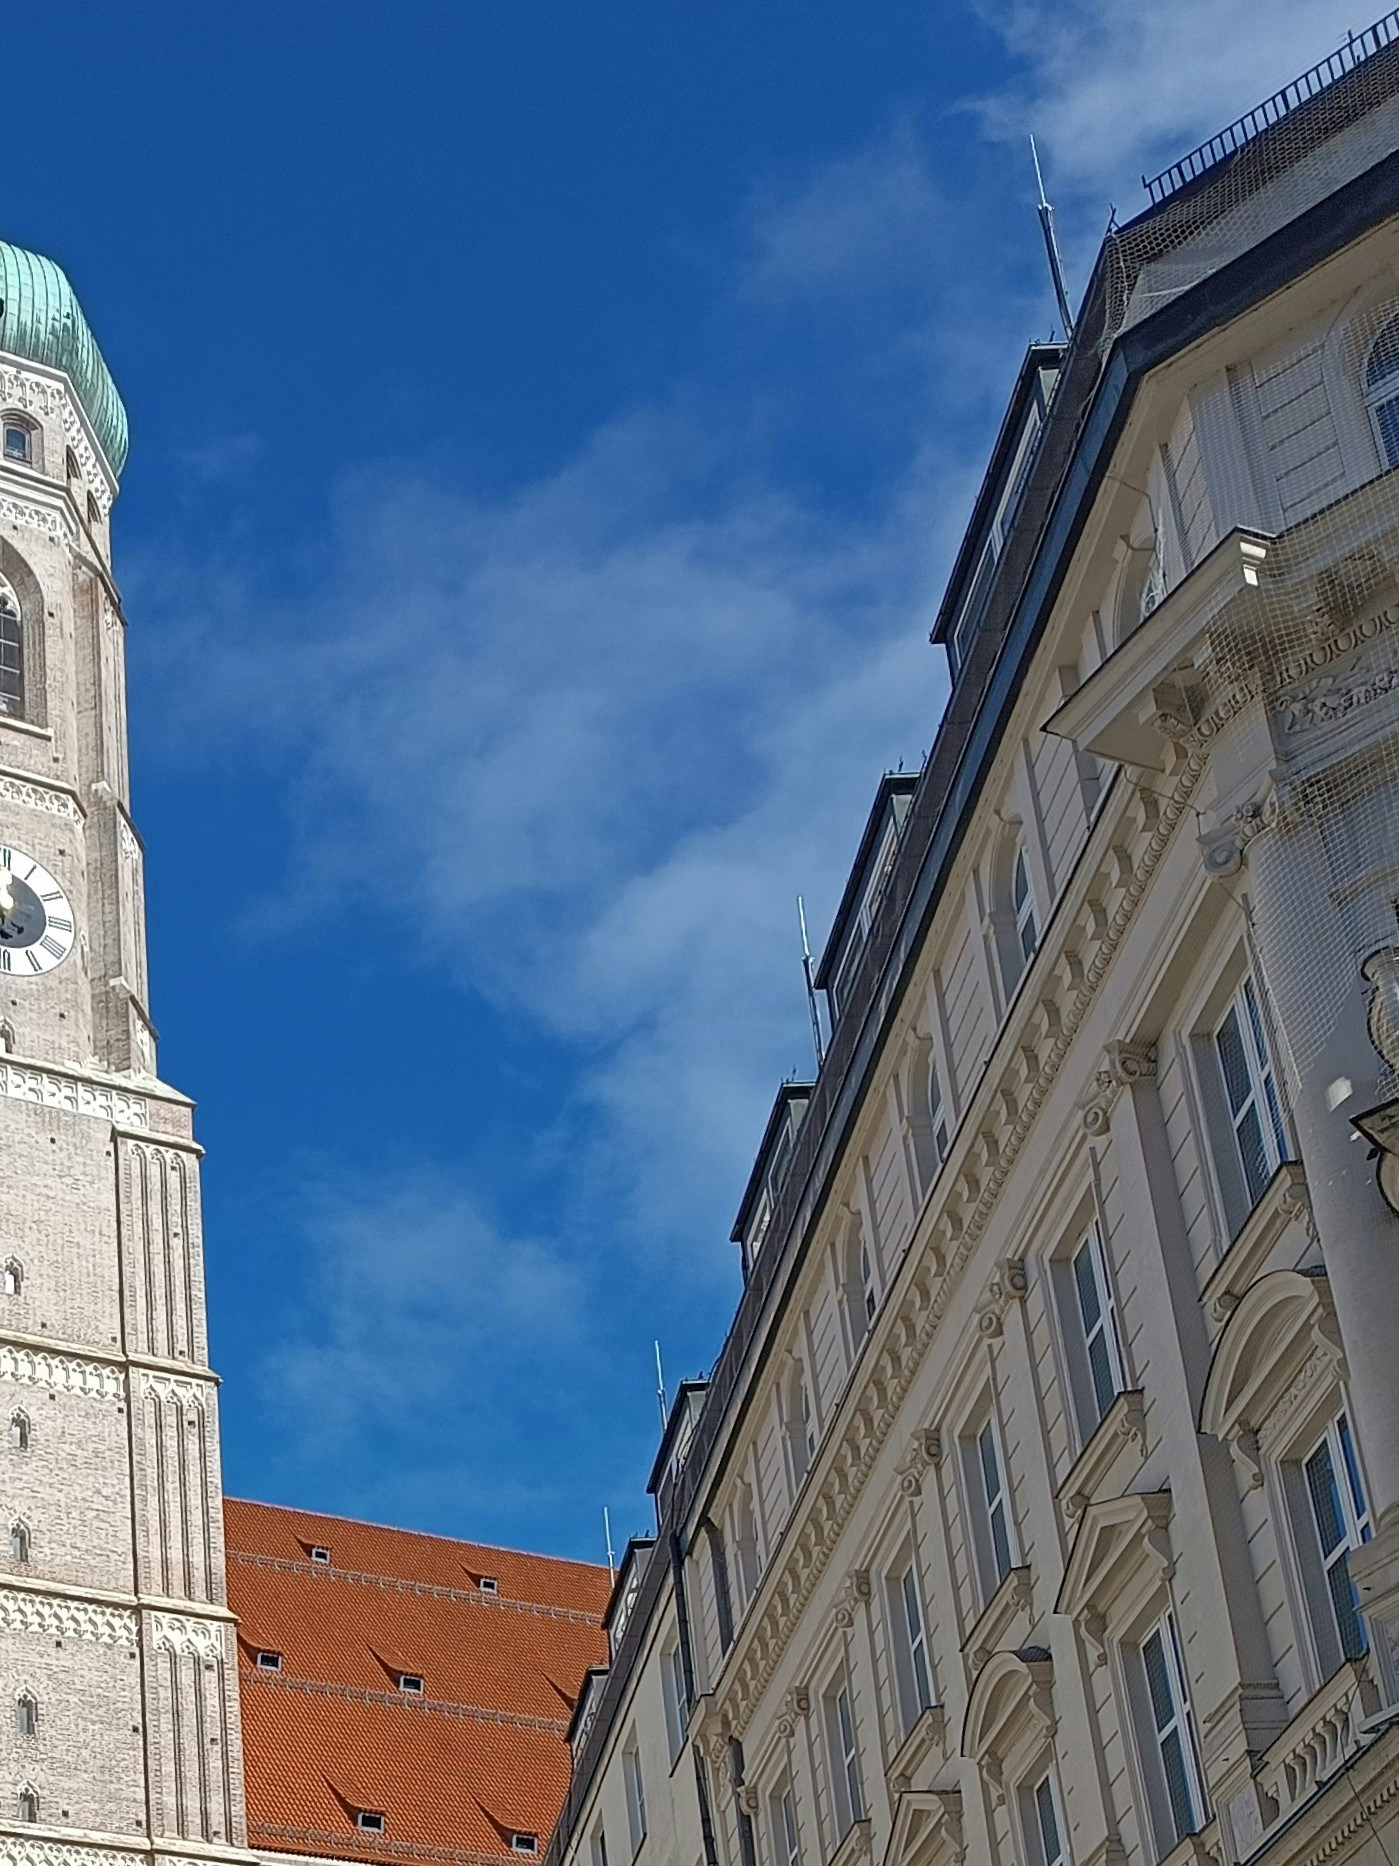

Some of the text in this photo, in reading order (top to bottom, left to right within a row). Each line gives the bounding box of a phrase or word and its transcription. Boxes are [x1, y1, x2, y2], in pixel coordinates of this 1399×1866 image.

[25, 864, 38, 881] I
[41, 890, 64, 902] II
[48, 915, 72, 933] III
